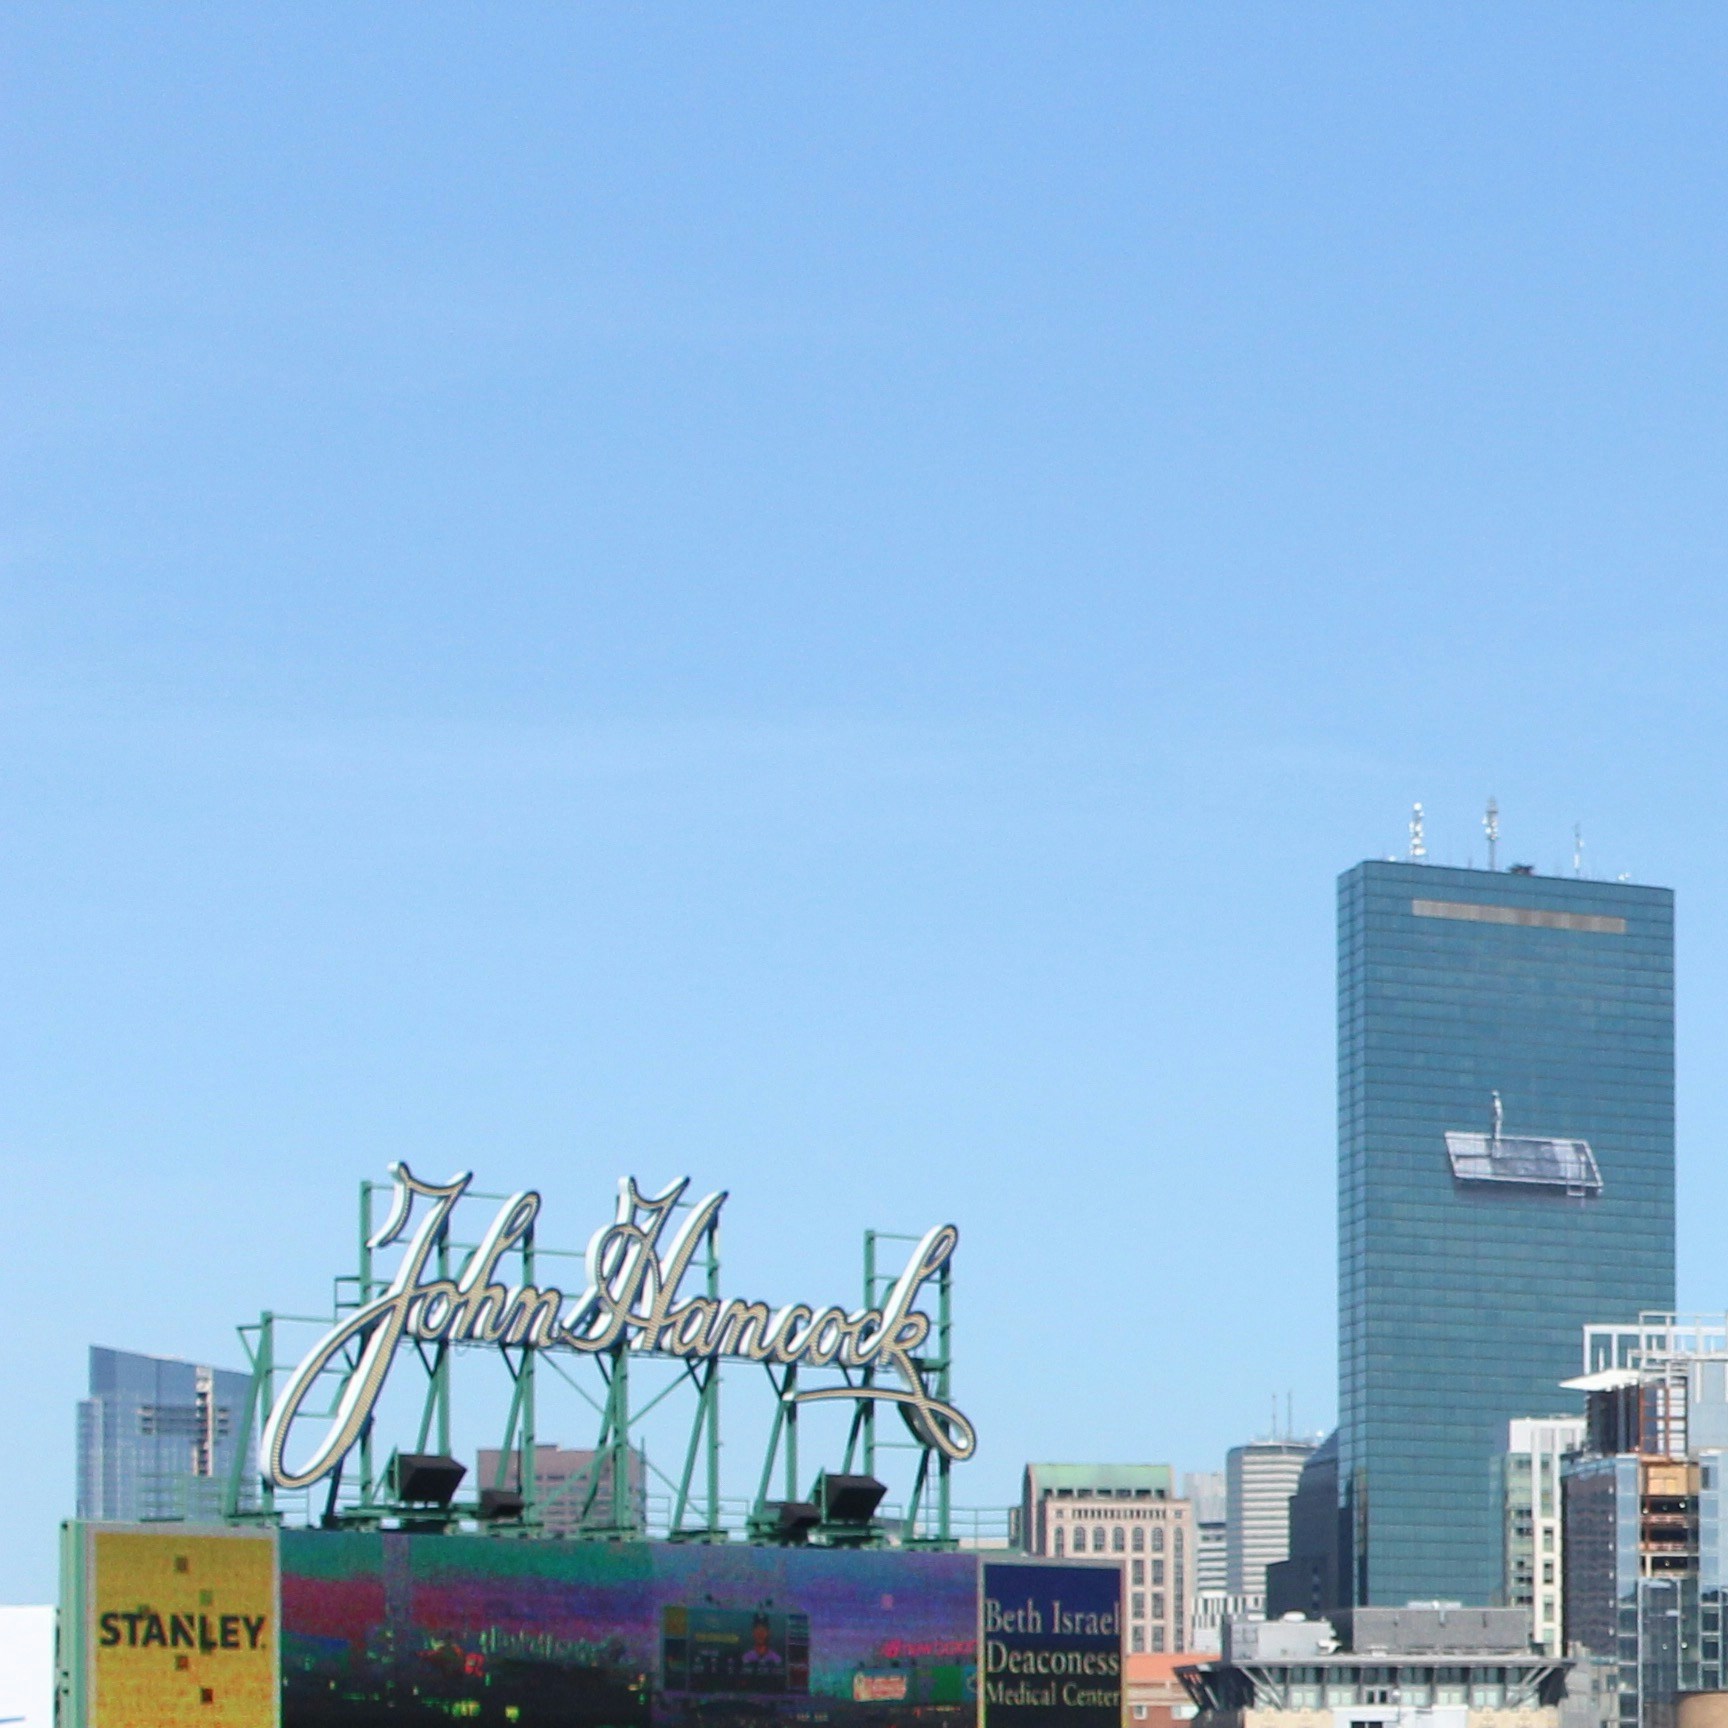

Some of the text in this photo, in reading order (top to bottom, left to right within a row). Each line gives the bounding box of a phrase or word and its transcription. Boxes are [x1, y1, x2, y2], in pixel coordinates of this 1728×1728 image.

[261, 1163, 977, 1488] John Hancock
[100, 1612, 266, 1651] STANLEY
[986, 1598, 1121, 1636] Beth Israel
[986, 1640, 1121, 1675] Deaconess
[986, 1680, 1121, 1708] Medical Center
